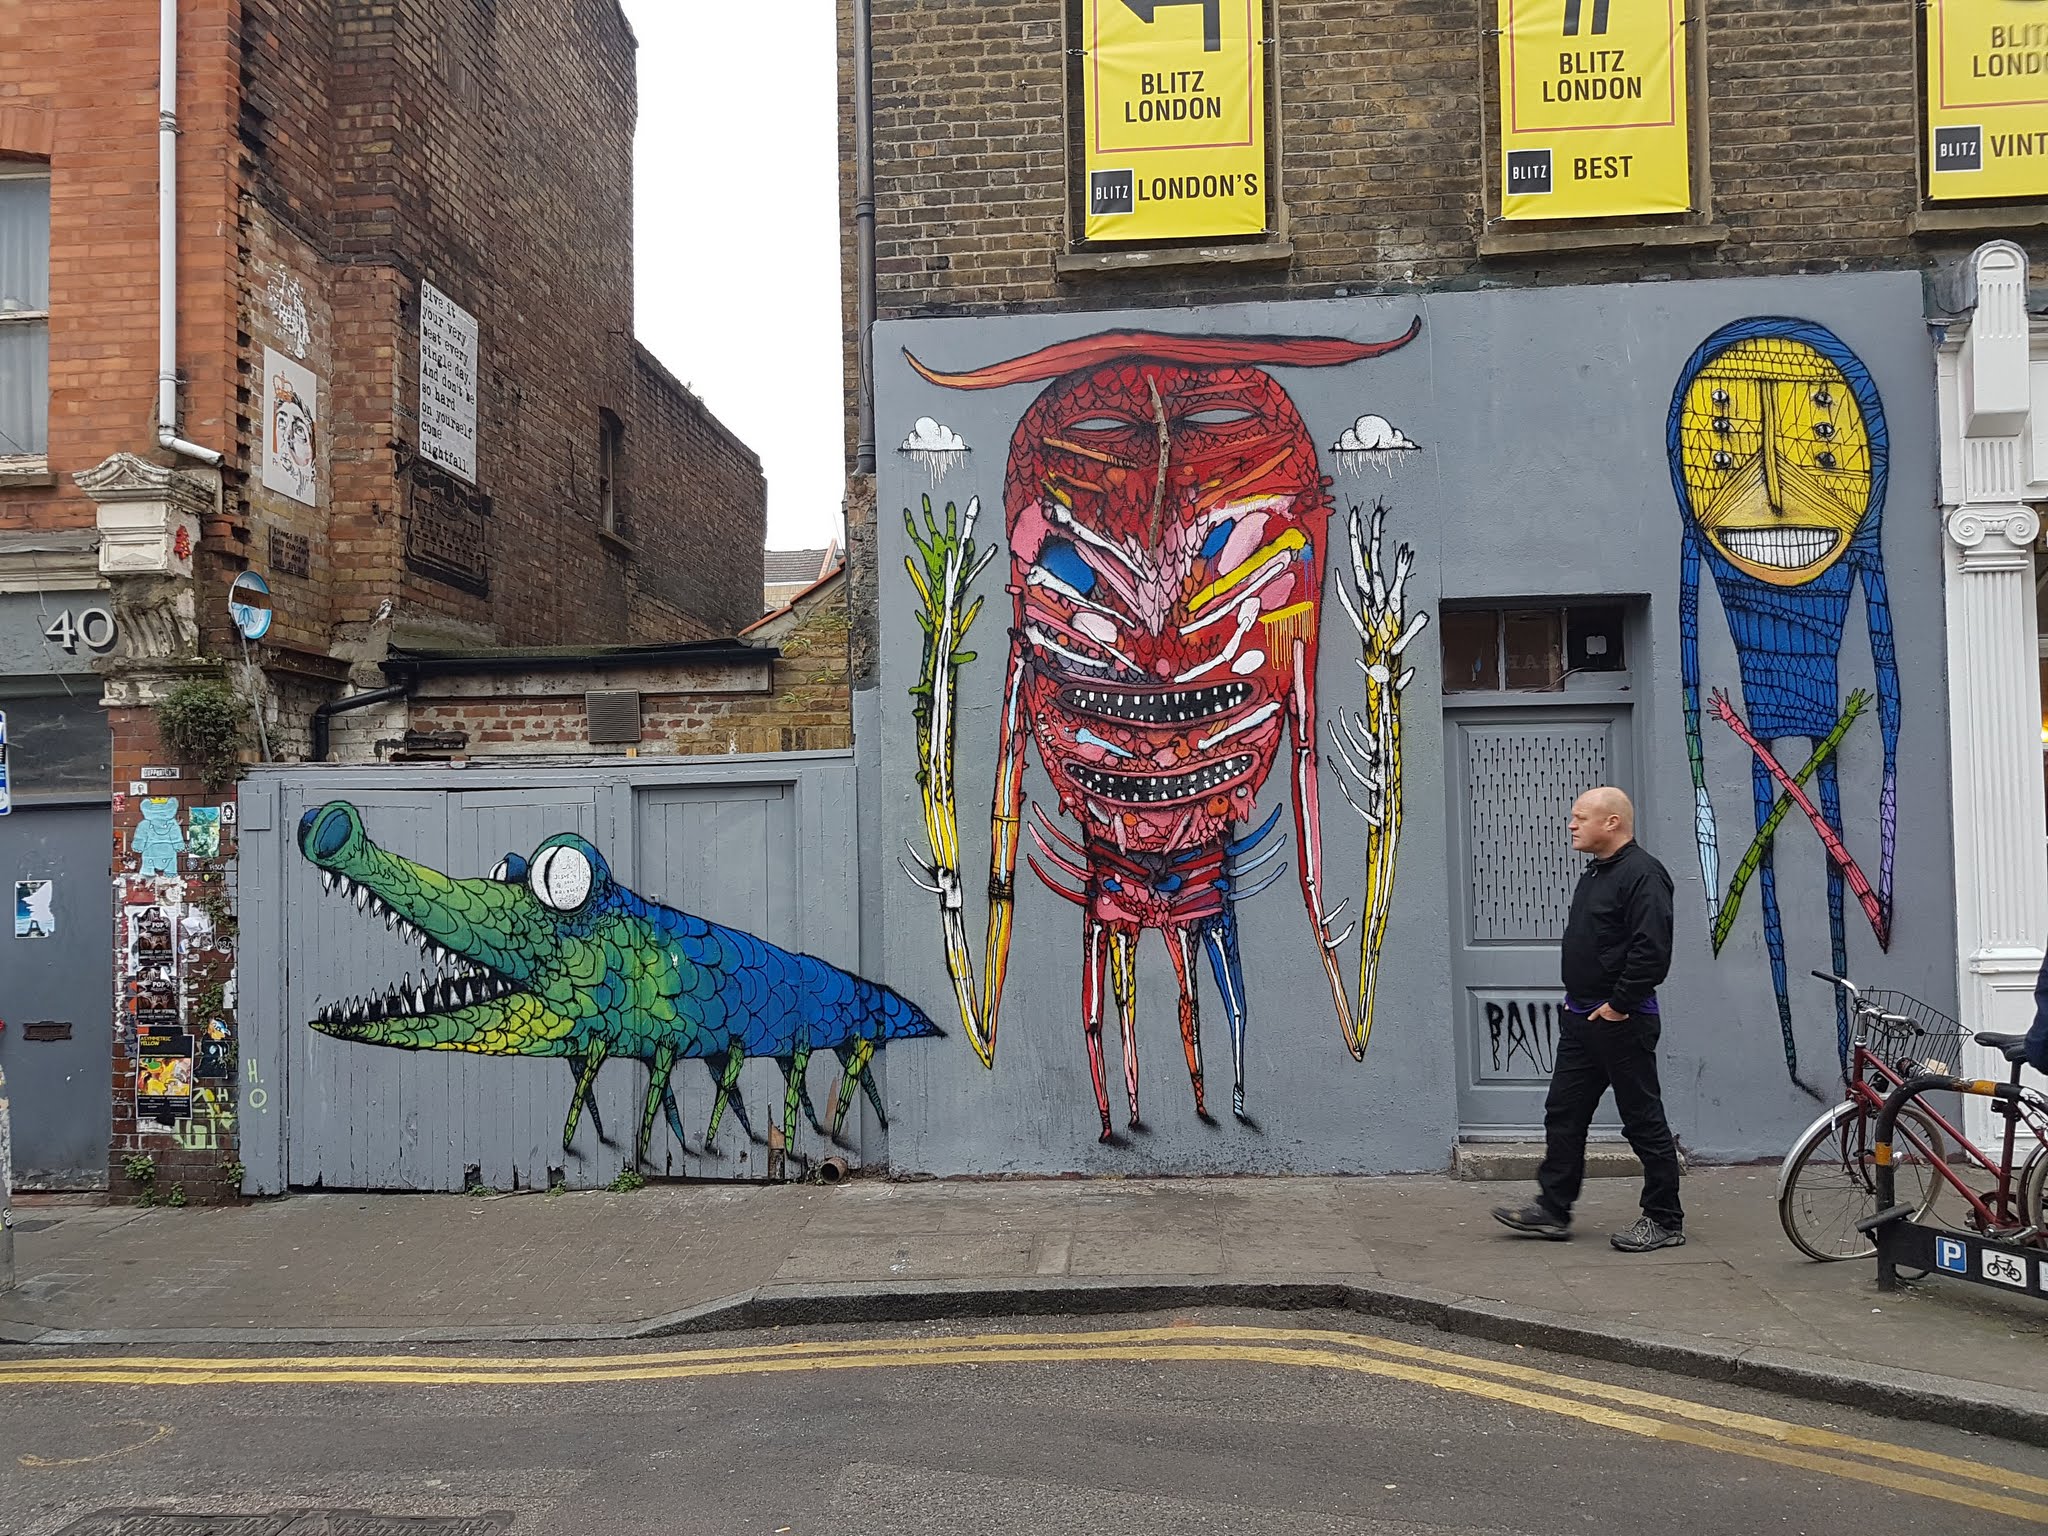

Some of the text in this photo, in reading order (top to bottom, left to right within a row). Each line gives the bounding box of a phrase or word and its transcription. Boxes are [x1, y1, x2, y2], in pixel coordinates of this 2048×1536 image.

[1992, 23, 2048, 48] BLIT
[1559, 50, 1625, 75] BLITZ
[1973, 51, 2048, 78] LOND
[1141, 71, 1205, 95] BLITZ
[1543, 76, 1642, 102] LONDON
[1125, 96, 1221, 123] LONDON
[1940, 141, 1977, 157] BLITZ
[1512, 155, 1633, 180] BLITZ BEST
[1096, 173, 1258, 201] BLITZ LONDON'S
[423, 284, 456, 318] Give it
[422, 305, 467, 347] your very
[422, 321, 468, 367] best every
[422, 344, 471, 386] single day.
[421, 382, 456, 411] so hard
[422, 361, 475, 405] And don't be
[421, 401, 432, 416] on
[436, 410, 473, 440] yourself
[421, 421, 442, 440] come
[421, 440, 470, 475] nightfall.
[45, 608, 118, 655] 40
[1943, 1241, 1961, 1267] P
